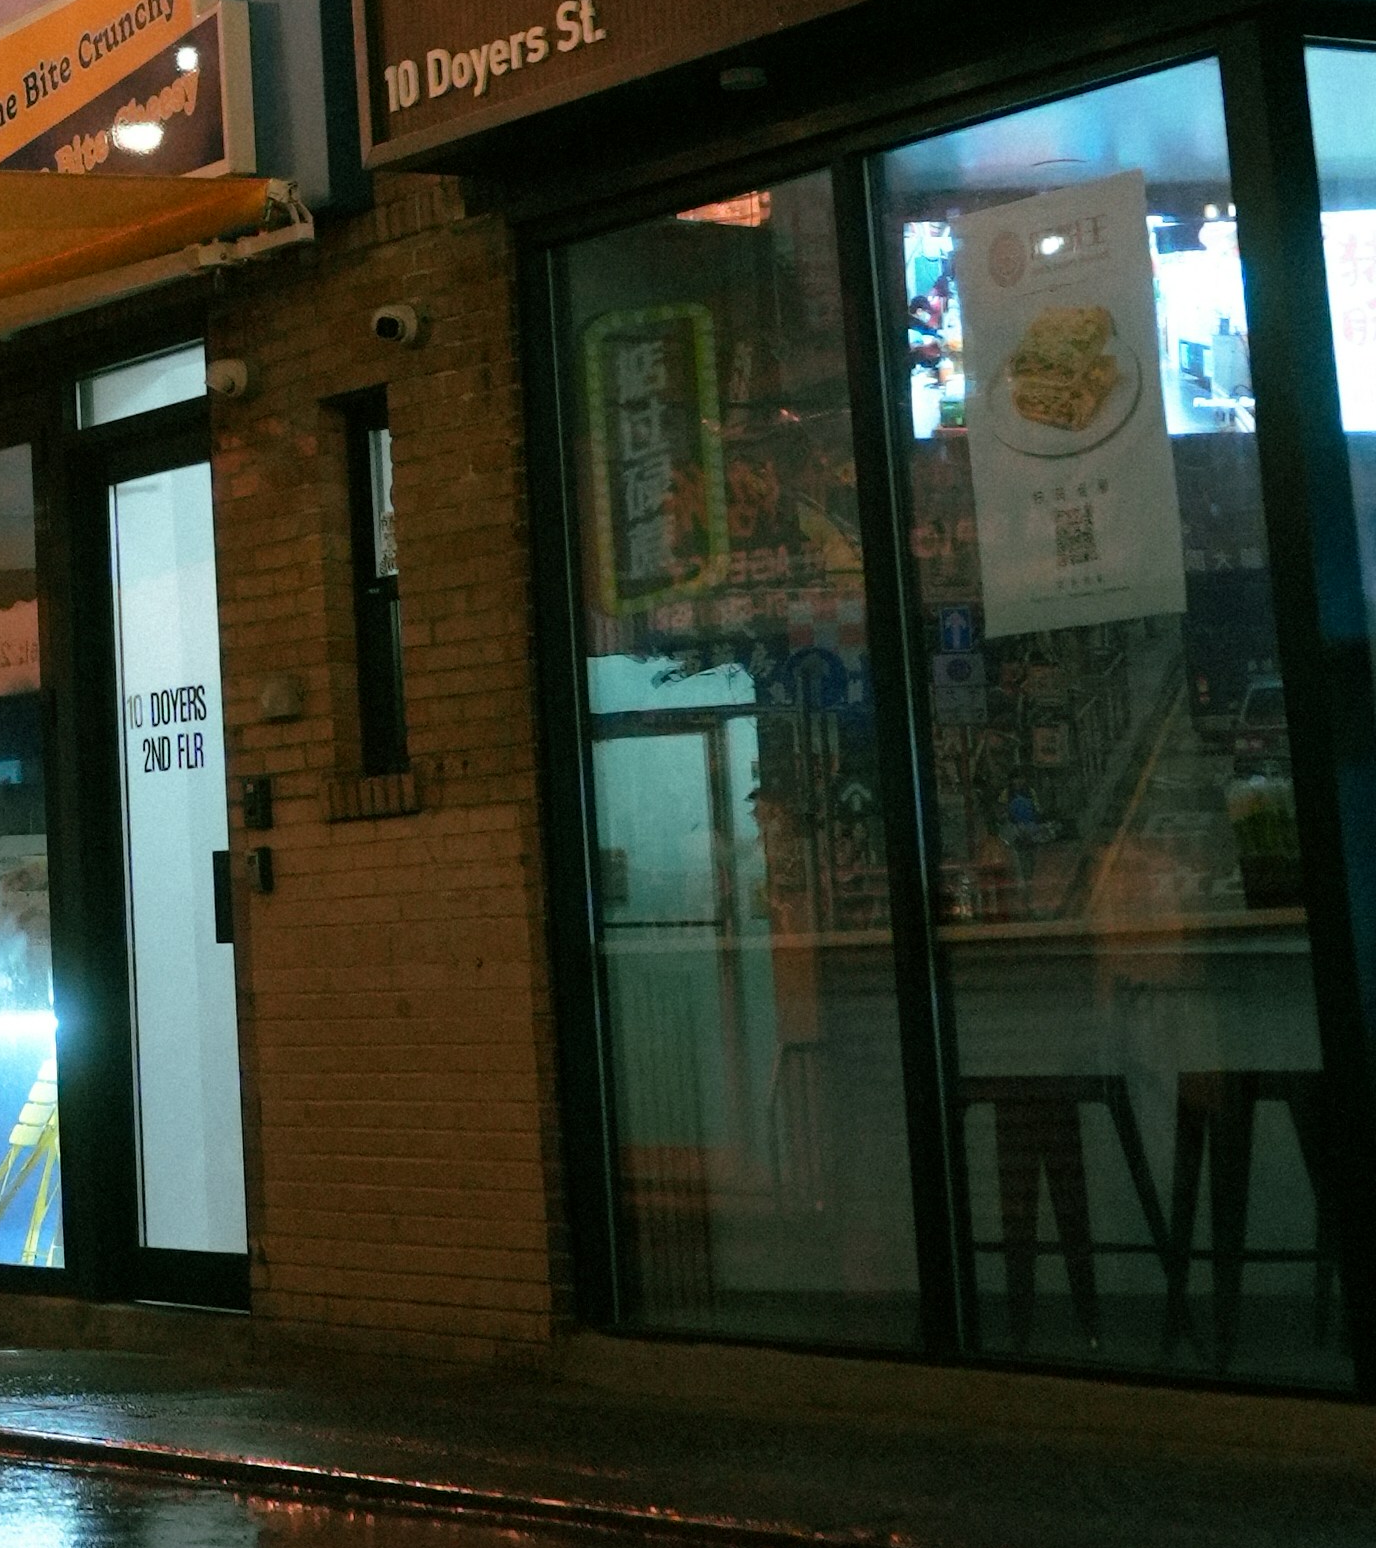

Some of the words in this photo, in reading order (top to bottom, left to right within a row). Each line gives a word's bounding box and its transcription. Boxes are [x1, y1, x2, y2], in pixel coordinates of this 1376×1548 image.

[22, 55, 72, 110] Bite
[384, 59, 420, 113] 10
[426, 25, 550, 99] Doyers
[54, 129, 110, 174] Bite
[127, 694, 144, 730] 10
[150, 684, 208, 727] DOYERS
[142, 735, 171, 774] 2ND
[177, 731, 205, 770] FLR
